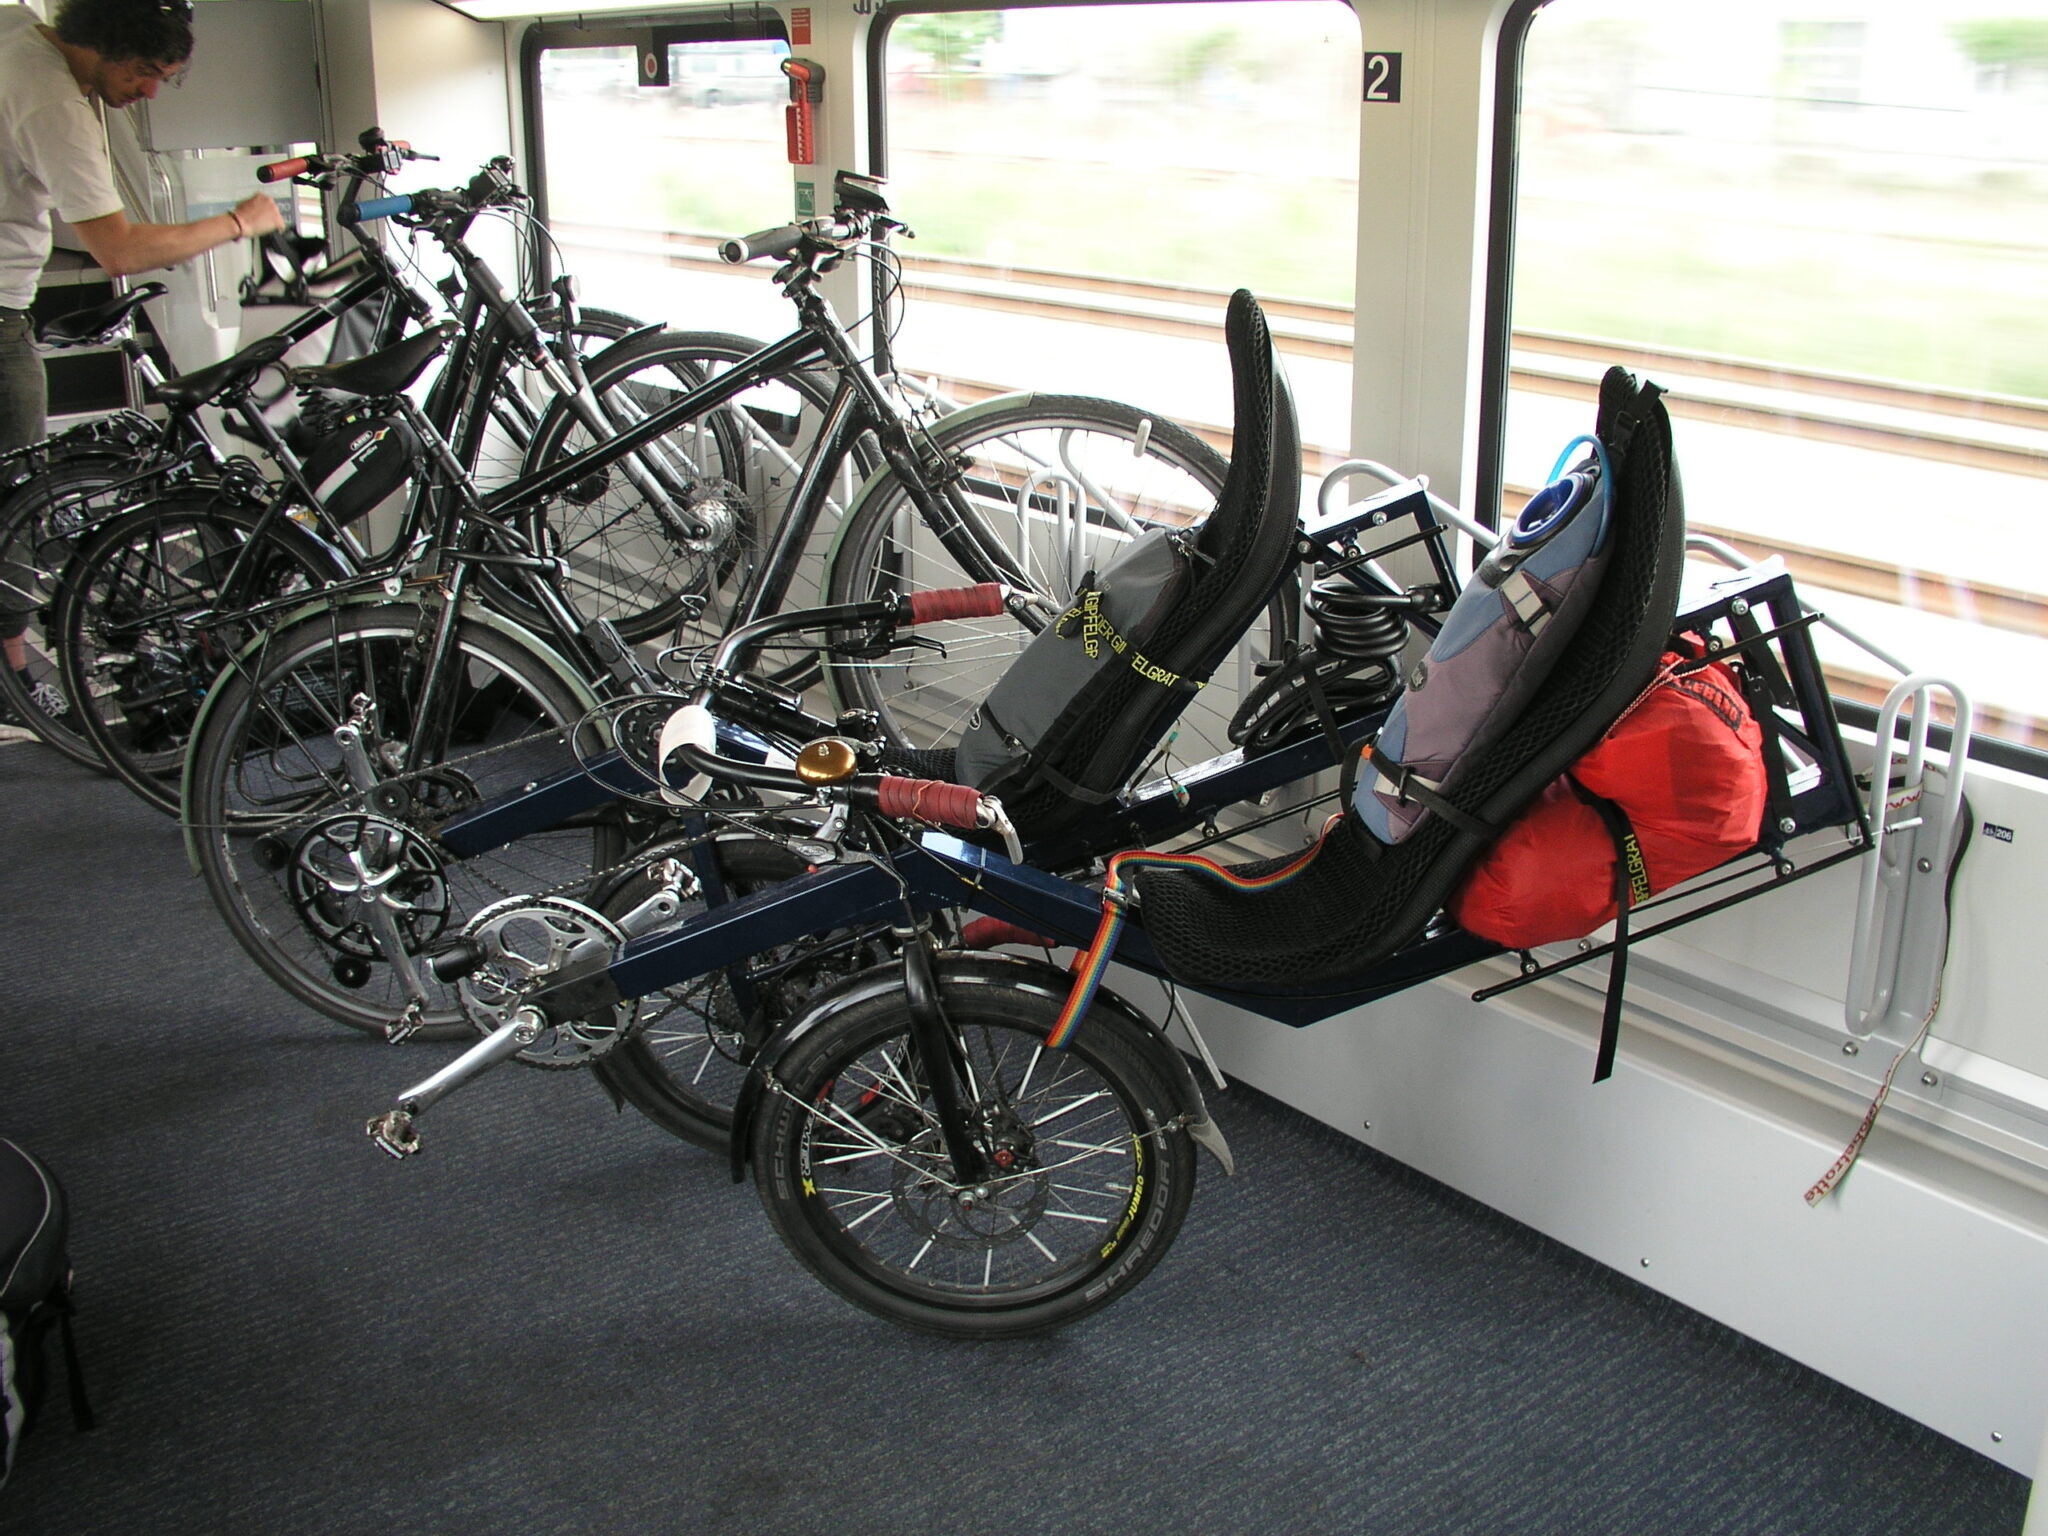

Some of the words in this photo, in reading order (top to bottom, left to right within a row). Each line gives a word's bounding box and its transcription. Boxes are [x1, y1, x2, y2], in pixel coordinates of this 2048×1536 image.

[1367, 55, 1389, 99] 2
[454, 369, 481, 455] CUBE
[1996, 829, 2012, 841] 206
[1127, 1175, 1144, 1221] JUMBO
